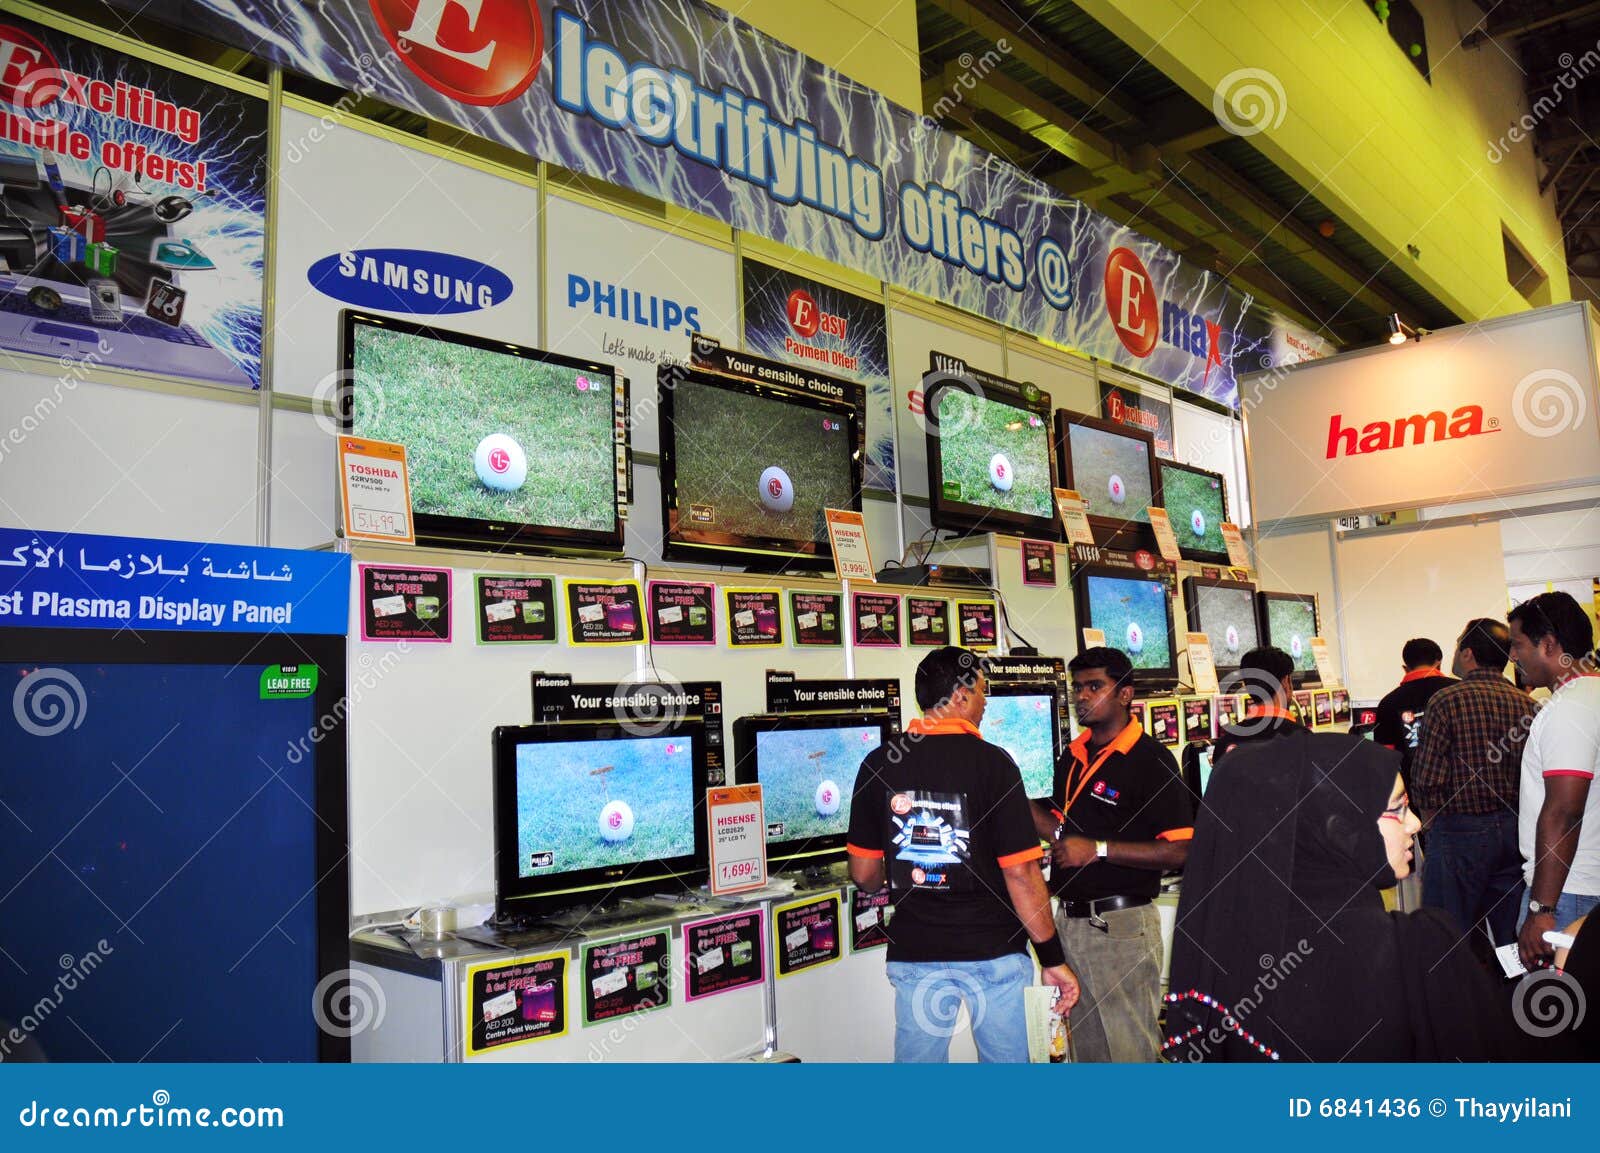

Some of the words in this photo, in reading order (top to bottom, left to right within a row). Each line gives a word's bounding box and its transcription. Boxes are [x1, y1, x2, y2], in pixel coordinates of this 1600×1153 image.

[102, 140, 207, 192] offers!
[902, 181, 1026, 291] offers
[338, 249, 494, 309] SAMSUNG
[567, 273, 701, 338] PHILIPS
[627, 344, 657, 365] make
[785, 337, 831, 364] Payment
[726, 355, 755, 375] Your
[758, 366, 805, 388] sensible
[808, 379, 844, 397] choice
[1325, 404, 1485, 459] hama
[349, 464, 398, 479] TOSHIBA
[80, 548, 189, 584] بلازما
[202, 556, 293, 583] شاشة
[395, 583, 423, 594] FREE
[504, 589, 528, 600] FREE
[31, 591, 131, 620] Plasma
[139, 597, 226, 626] Display
[232, 601, 292, 624] Panel
[988, 663, 1004, 674] Your
[1005, 663, 1032, 674] sensible
[1033, 663, 1054, 674] choice
[267, 678, 288, 689] LEAD
[290, 678, 311, 689] FREE
[571, 695, 602, 708] Your
[605, 694, 657, 708] sensible
[661, 692, 700, 705] choice
[794, 689, 816, 701] Your
[818, 688, 855, 701] sensible
[857, 687, 885, 700] choice
[717, 814, 757, 827] HISENSE
[615, 951, 643, 967] FREE
[507, 976, 537, 992] FREE
[485, 1030, 506, 1040] Centre
[507, 1025, 524, 1035] Point
[525, 1021, 550, 1032] Voucher
[486, 1022, 500, 1031] AED
[501, 1017, 515, 1027] 200
